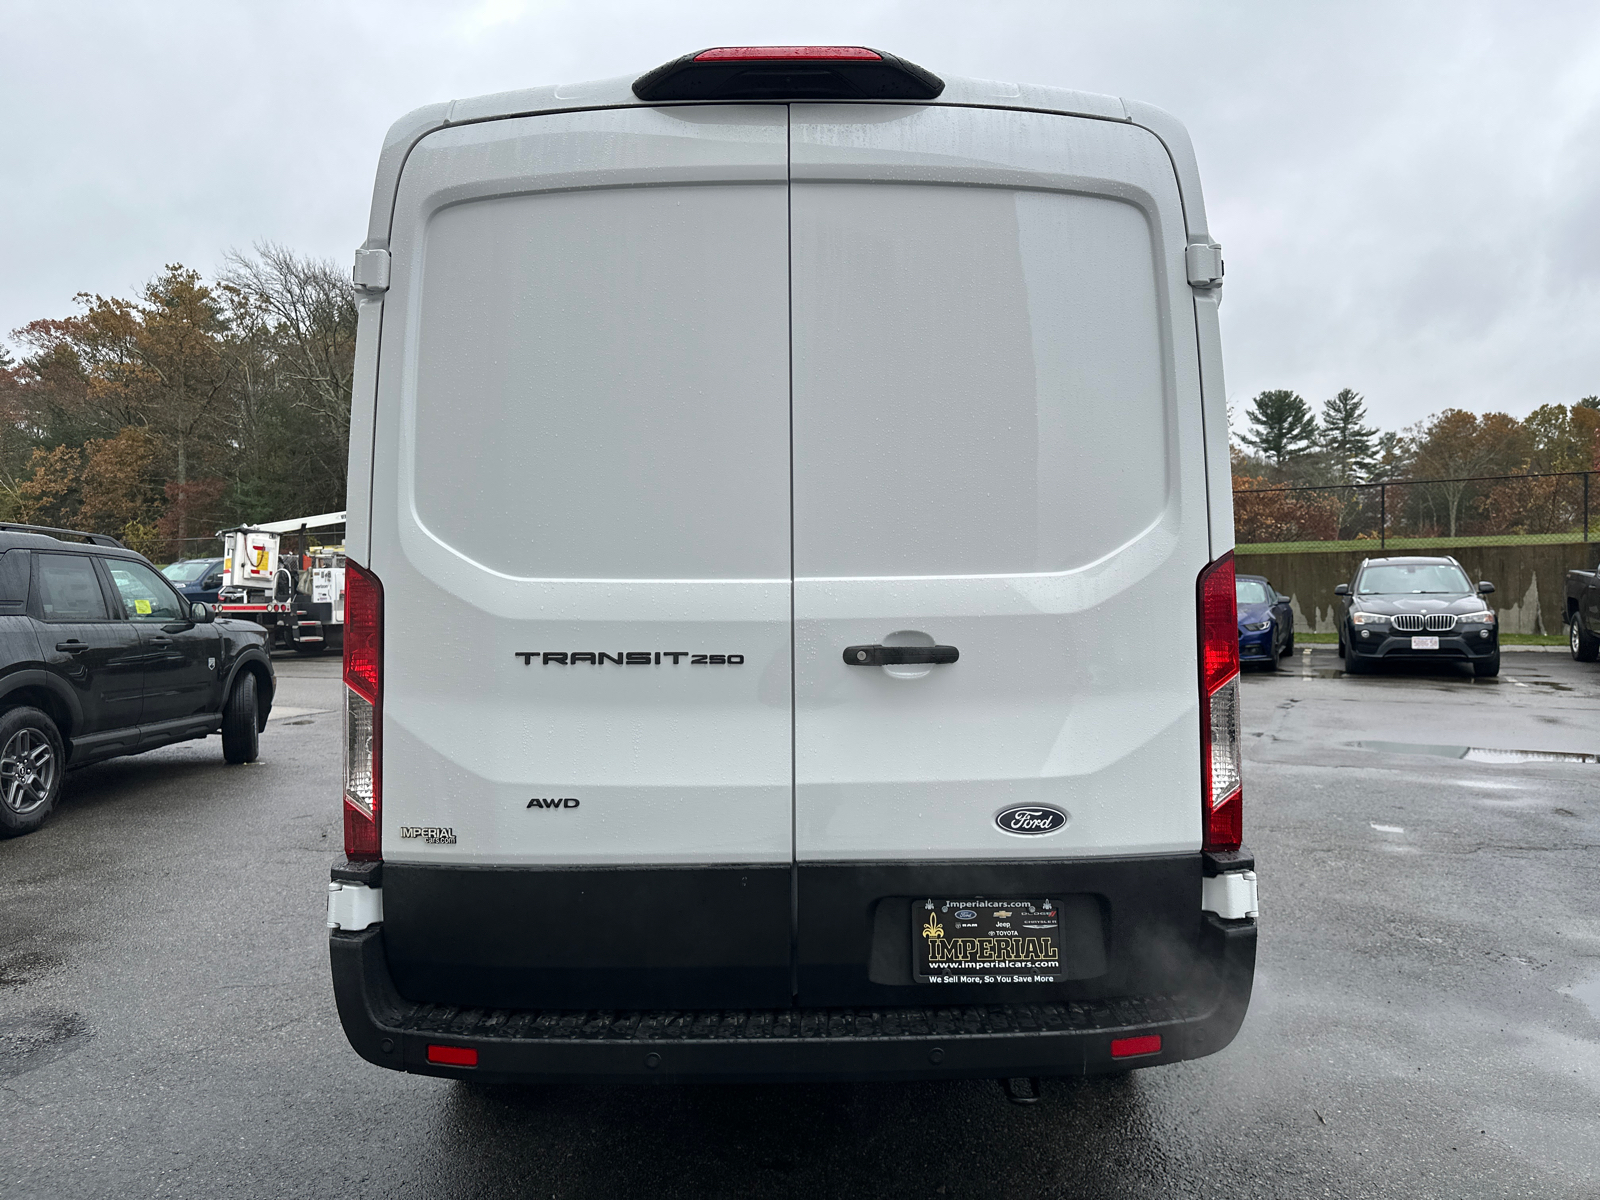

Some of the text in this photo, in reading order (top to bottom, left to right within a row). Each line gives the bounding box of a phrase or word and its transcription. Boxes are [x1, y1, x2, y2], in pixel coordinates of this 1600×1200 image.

[515, 652, 744, 665] TRANSIT 250
[526, 798, 580, 808] AWD
[1010, 810, 1053, 829] Ford
[401, 827, 456, 838] IMPERIAL
[946, 900, 1031, 909] Imperialcars.com
[929, 938, 1059, 960] IMPERIAL
[929, 960, 1059, 970] www.imperialcars.com
[960, 976, 983, 984] More,
